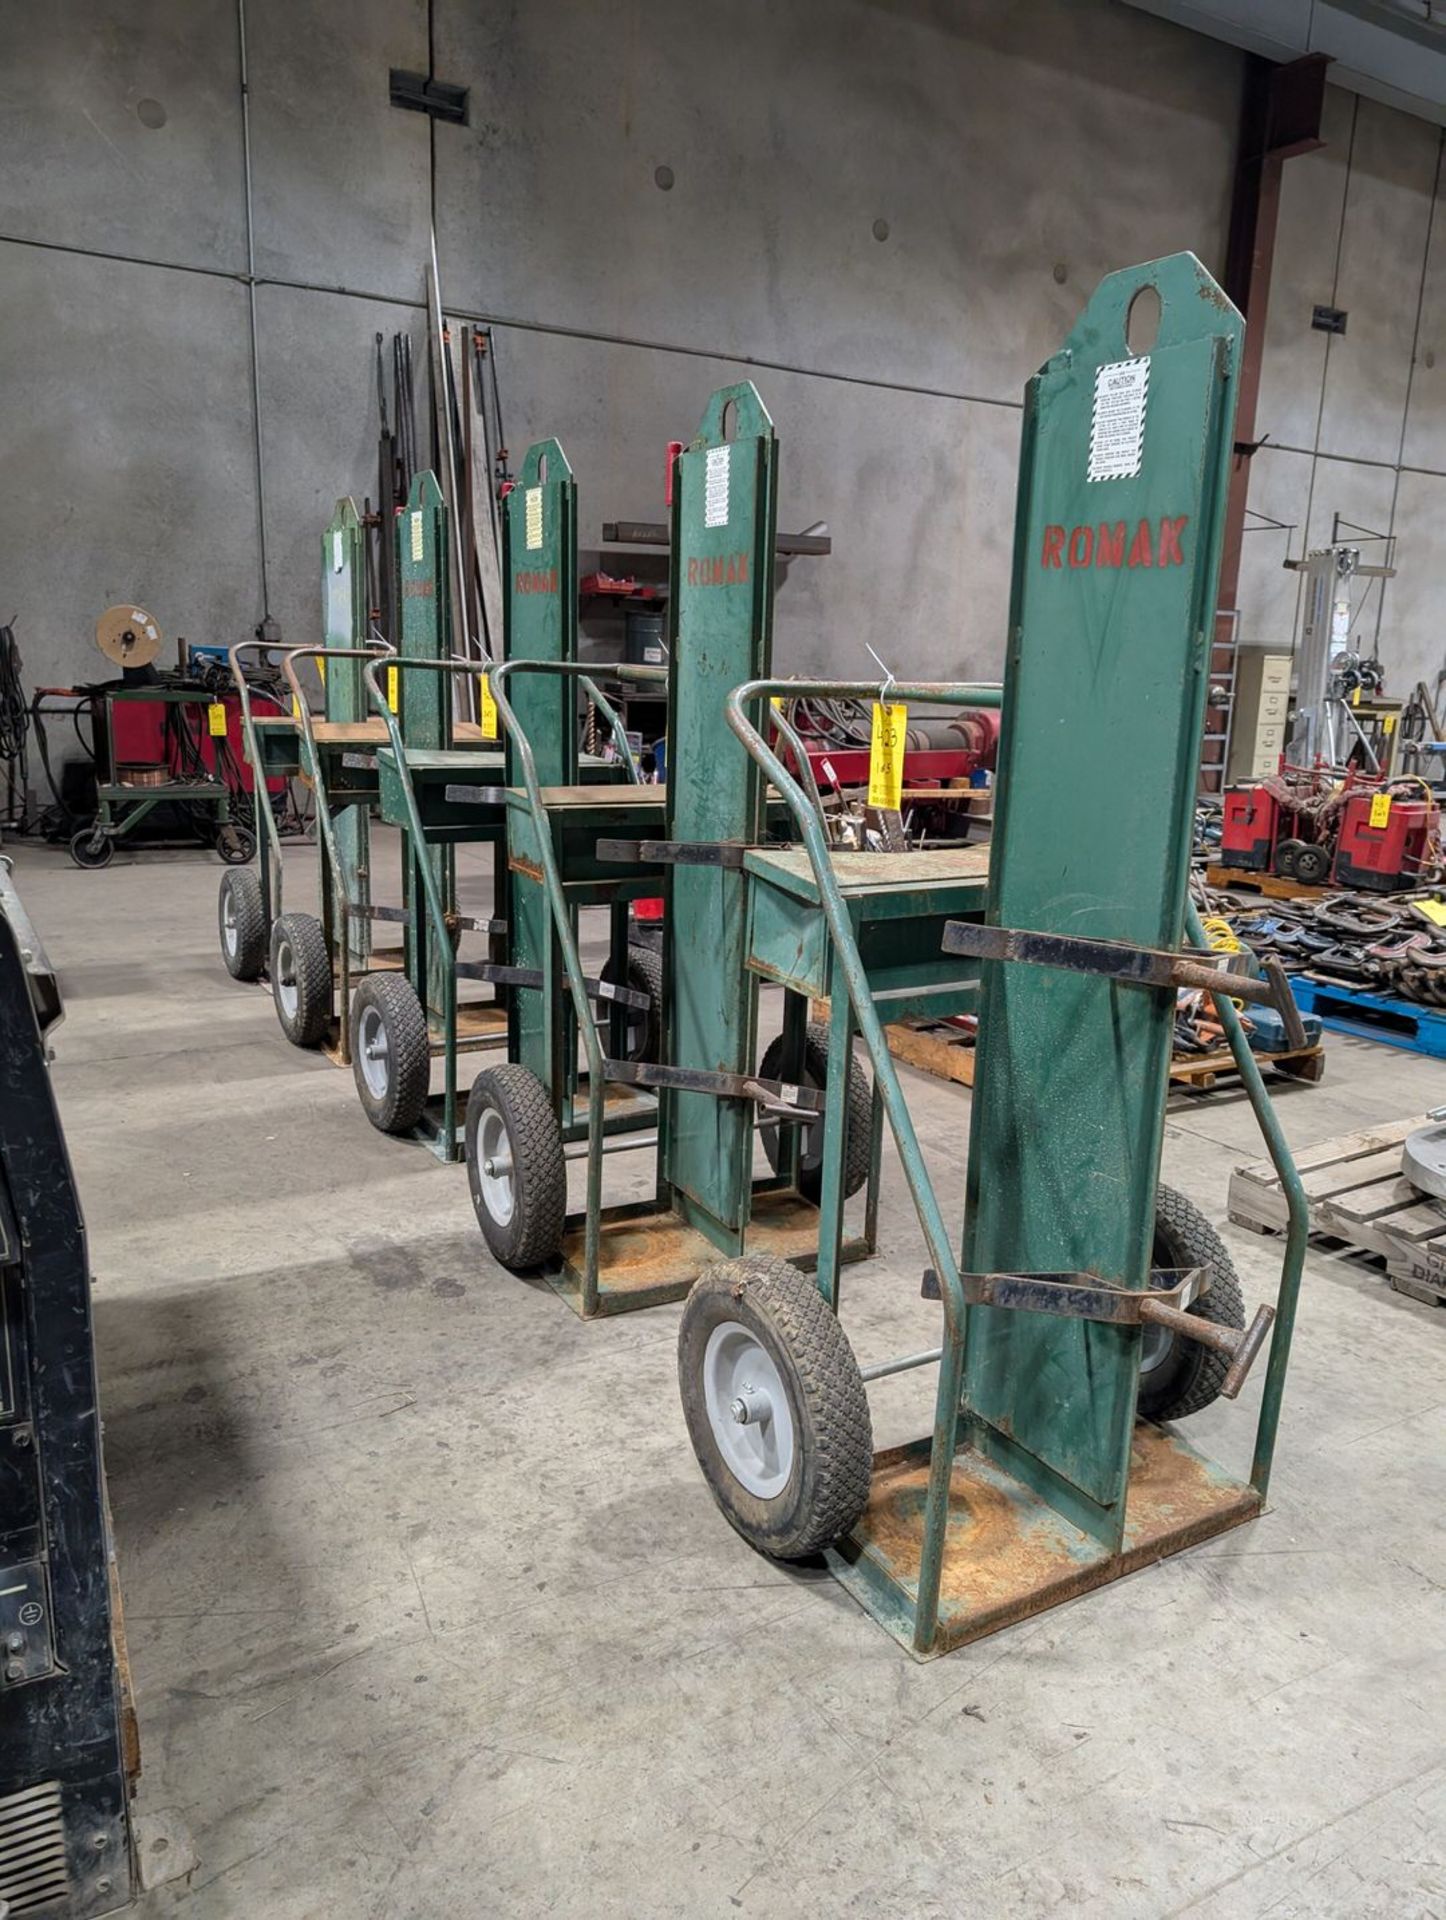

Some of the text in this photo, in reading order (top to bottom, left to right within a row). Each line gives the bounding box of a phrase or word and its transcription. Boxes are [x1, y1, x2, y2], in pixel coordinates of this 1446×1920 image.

[1107, 374, 1136, 387] CAUTION
[1041, 514, 1188, 570] ROMAK
[688, 552, 749, 586] ROMAK
[1426, 1252, 1446, 1272] G
[1412, 1263, 1446, 1289] DIA
